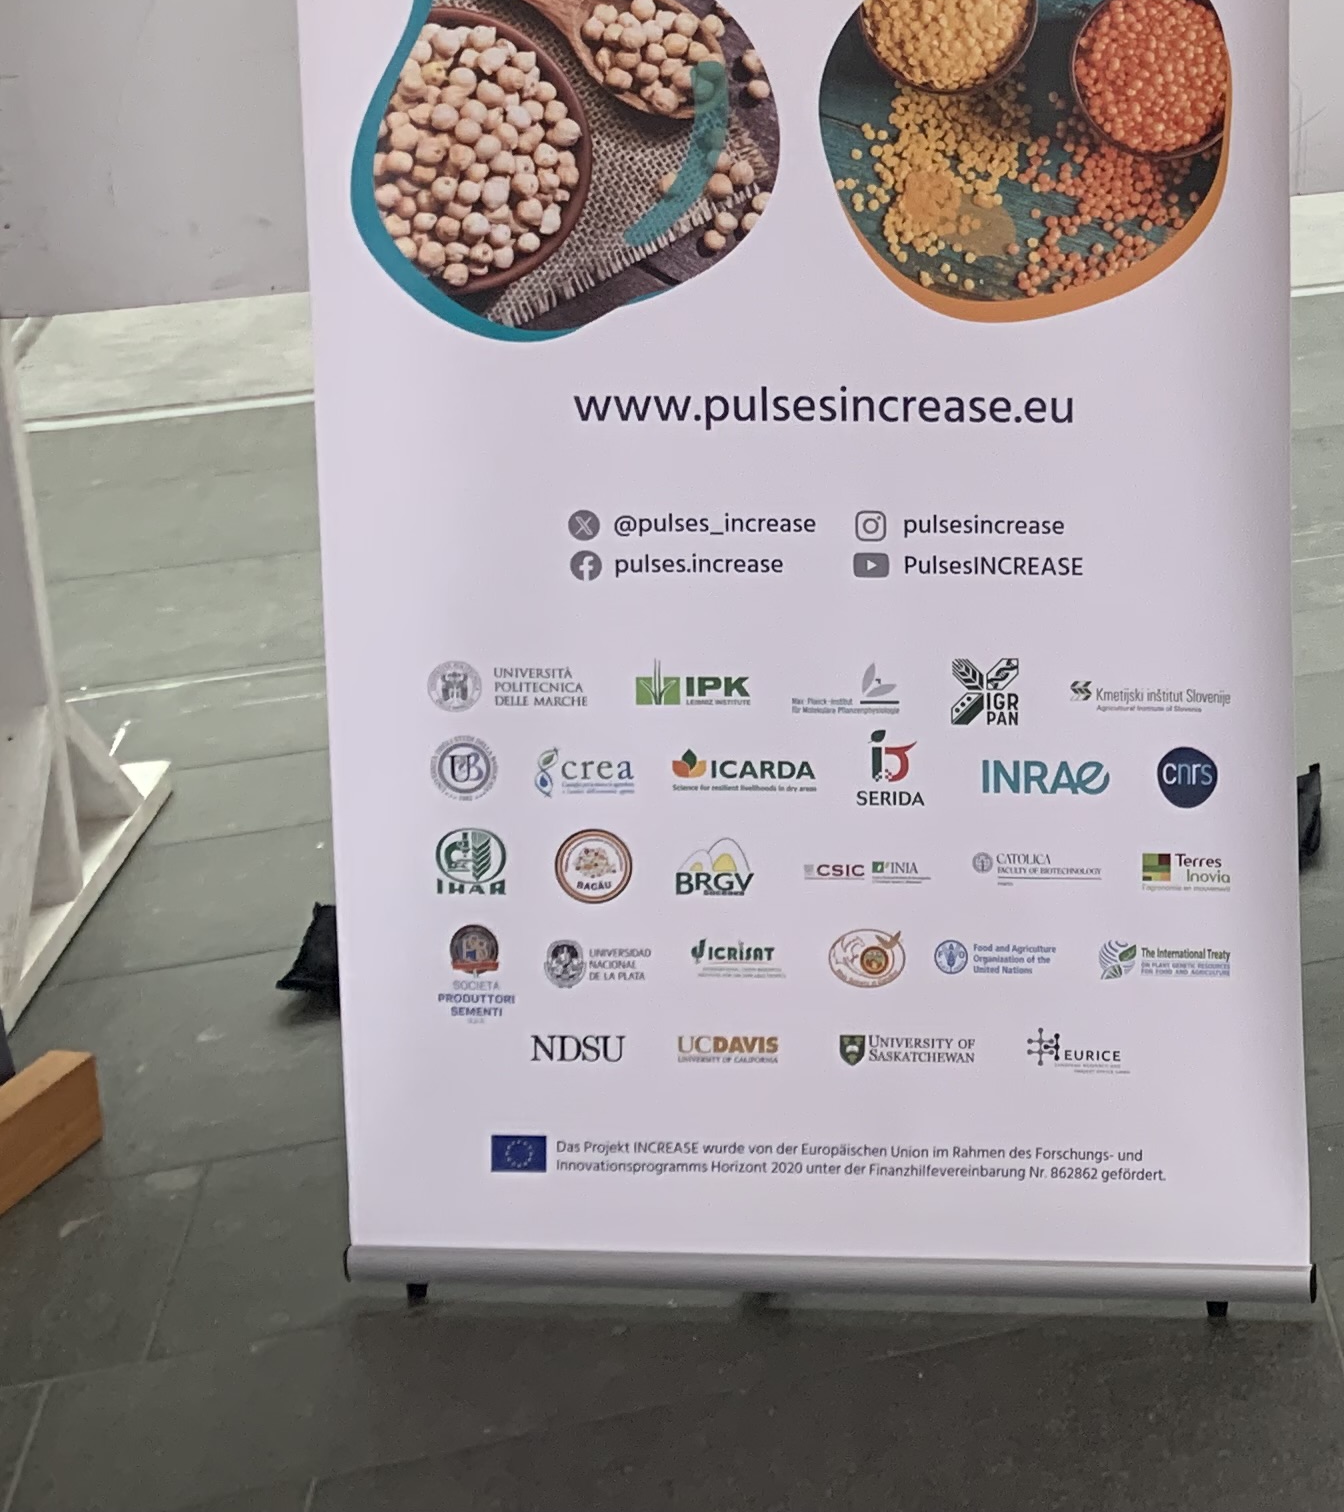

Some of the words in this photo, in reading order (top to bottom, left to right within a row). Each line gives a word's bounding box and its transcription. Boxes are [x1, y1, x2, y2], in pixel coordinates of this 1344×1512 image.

[573, 385, 1073, 431] www.pulsesincrease.eu
[614, 512, 816, 537] @pulses_increase
[903, 514, 1064, 538] pulsesincrease
[615, 552, 783, 578] pulses.increase
[904, 555, 1083, 576] PulsesINCREASE
[493, 666, 573, 679] UNIVERSITÀ
[494, 681, 583, 693] POLITECNICA
[685, 676, 750, 697] IPK
[494, 695, 529, 706] DELLE
[533, 695, 587, 707] MARCHE
[986, 692, 1018, 710] IGR
[986, 710, 1018, 726] PAN
[561, 760, 634, 780] crea
[711, 760, 816, 780] ICARDA
[1162, 762, 1213, 785] cnrs
[856, 790, 925, 806] SERIDA
[1174, 853, 1222, 868] Terres
[816, 863, 865, 877] CSIC
[1186, 868, 1231, 883] Inovia
[675, 872, 754, 895] BRGV
[1140, 947, 1155, 958] The
[1156, 947, 1206, 959] International
[1206, 948, 1231, 963] Treaty
[531, 1034, 625, 1062] NDSU
[868, 1034, 953, 1051] UNIVERSITY
[957, 1038, 975, 1049] OF
[868, 1047, 975, 1063] SASKATCHEWAN
[1064, 1049, 1121, 1062] EURICE
[556, 1140, 580, 1153] Das
[583, 1140, 630, 1156] Projekt
[633, 1141, 699, 1154] INCREASE
[702, 1141, 745, 1154] wurde
[748, 1144, 773, 1155] von
[776, 1142, 798, 1155] der
[801, 1142, 887, 1158] Europäischen
[890, 1145, 929, 1158] Union
[932, 1146, 949, 1158] im
[952, 1145, 1005, 1159] Rahmen
[1008, 1146, 1032, 1159] des
[1035, 1146, 1114, 1164] Forschungs-
[1117, 1148, 1143, 1162] und
